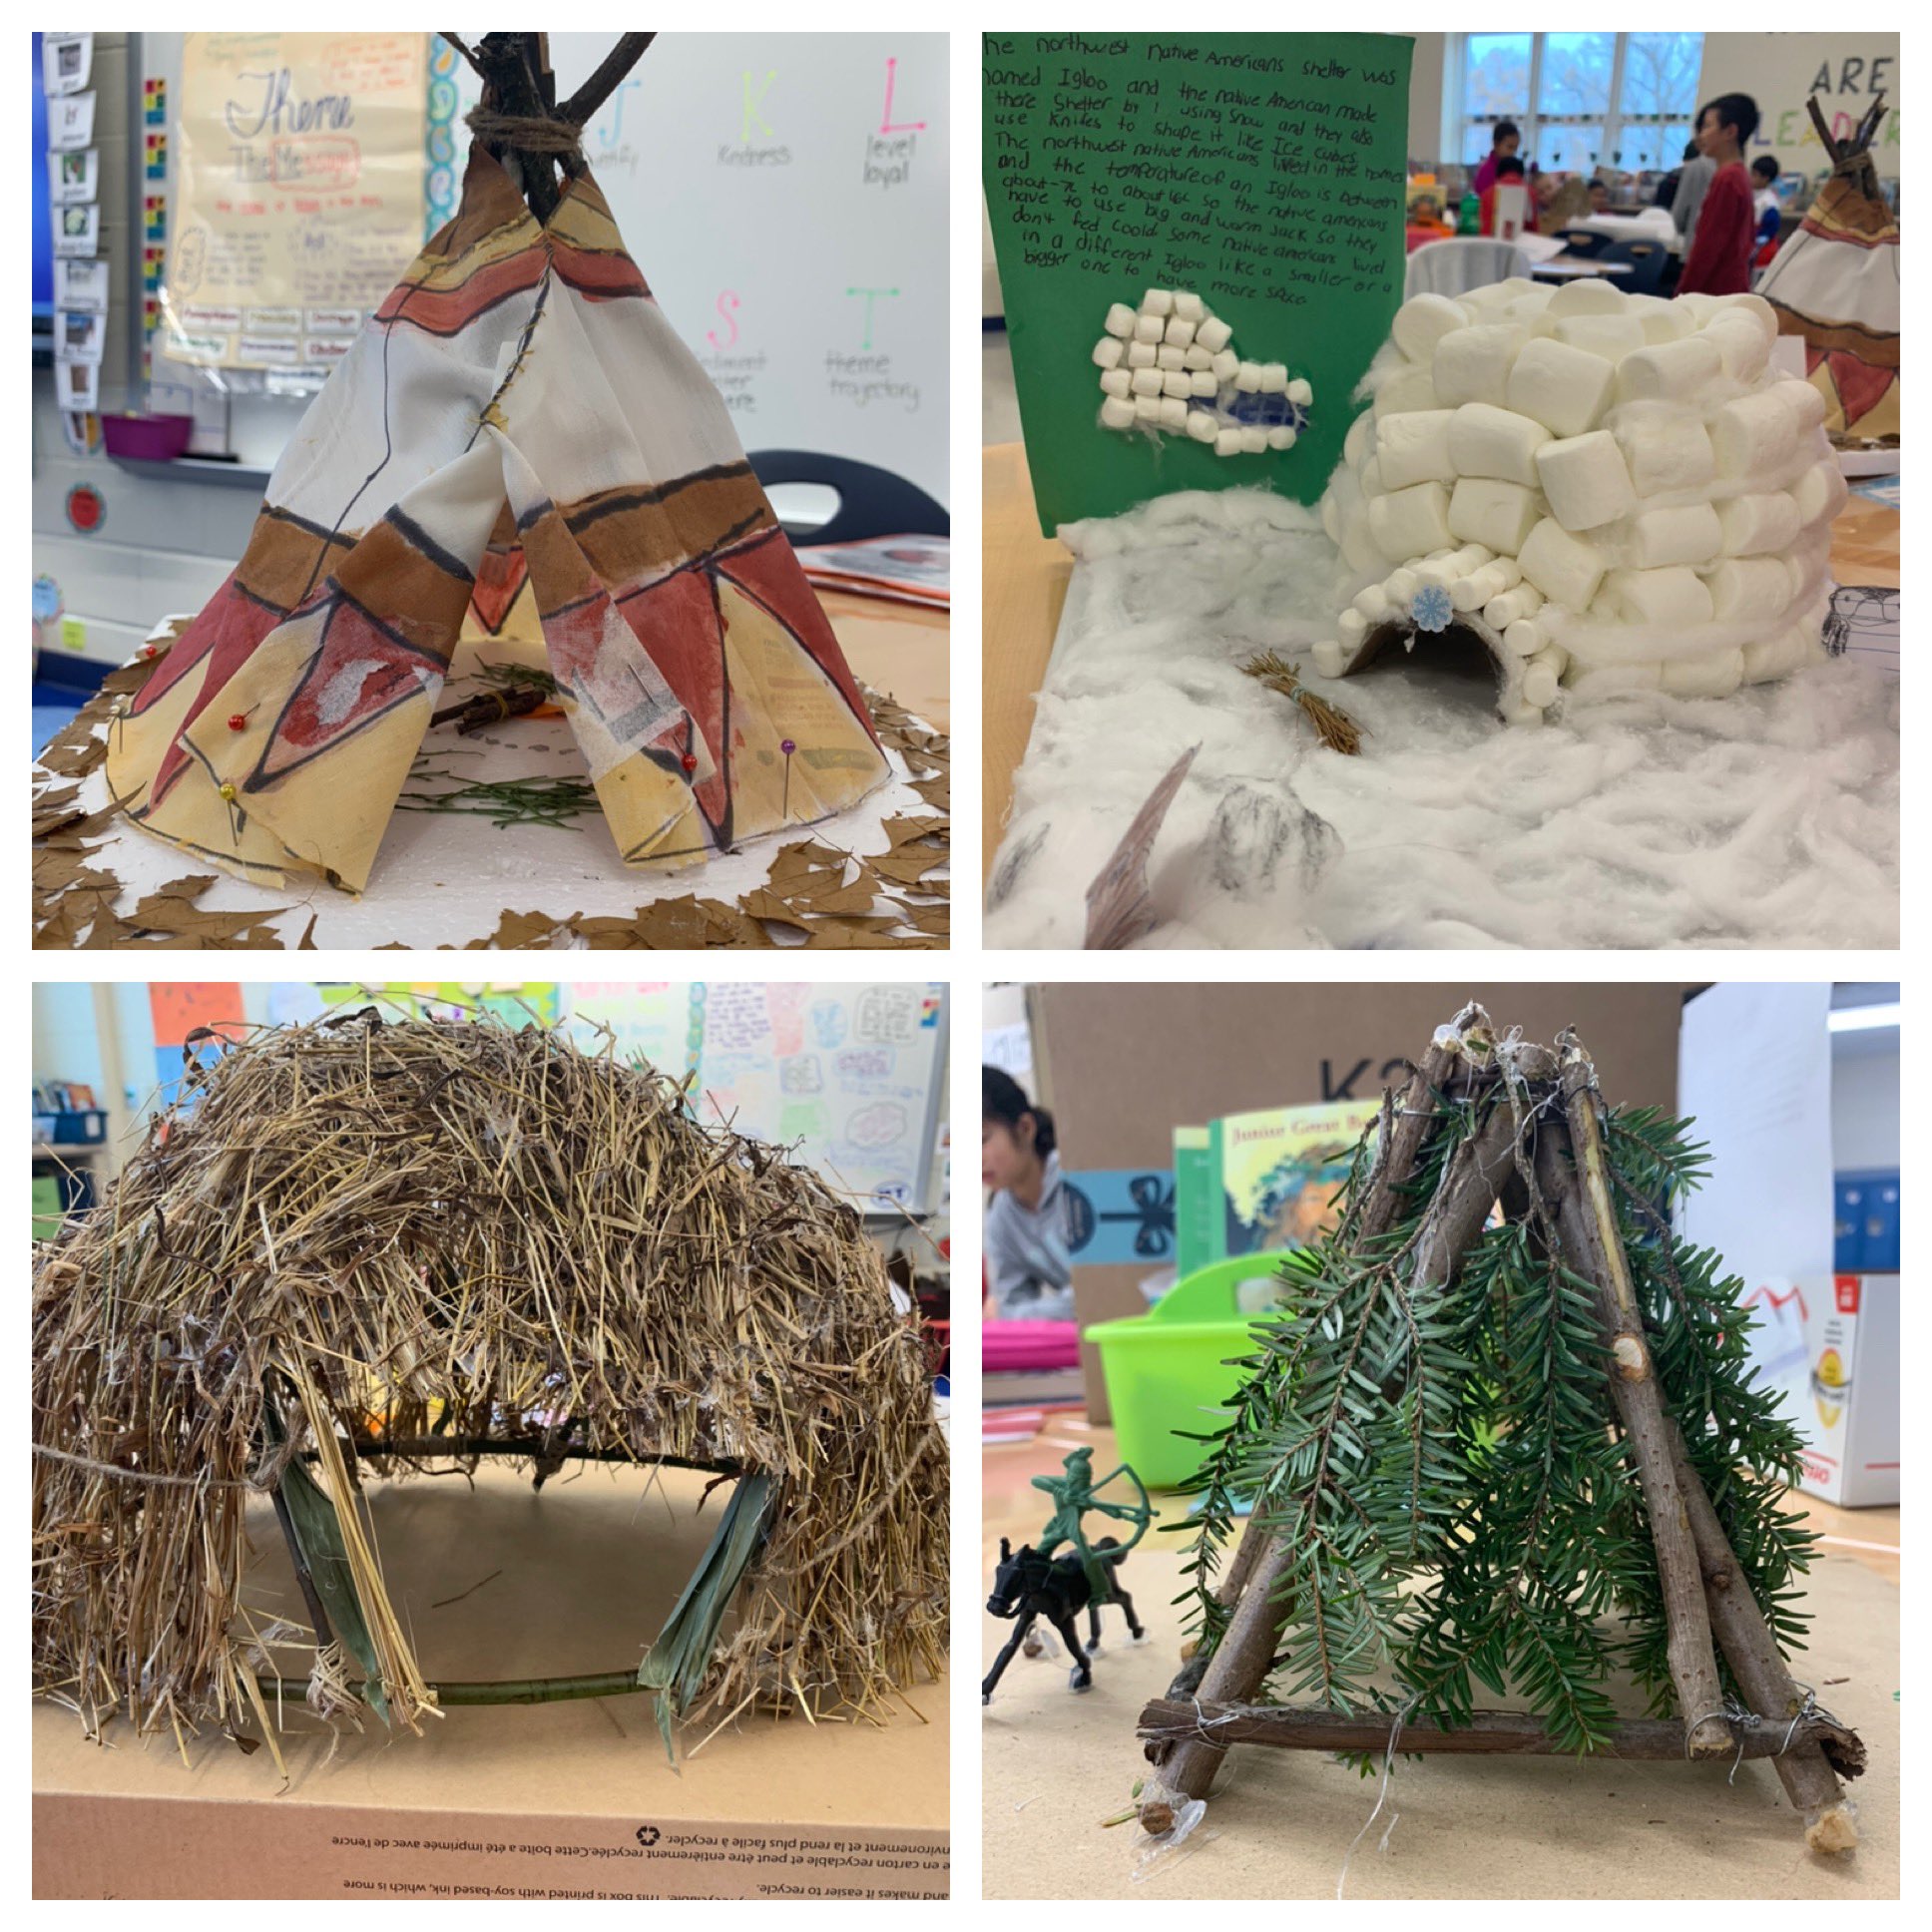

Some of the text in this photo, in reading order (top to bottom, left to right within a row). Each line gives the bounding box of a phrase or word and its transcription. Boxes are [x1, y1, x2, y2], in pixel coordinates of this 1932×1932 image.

[1809, 57, 1894, 94] ARE
[1058, 67, 1108, 91] Igloo
[1127, 80, 1160, 96] and
[373, 1838, 390, 1850] de
[392, 1839, 421, 1849] avec
[423, 1841, 483, 1853] imprimée
[731, 1838, 766, 1850] facile
[769, 1838, 796, 1851] plus
[799, 1840, 830, 1852] rend
[833, 1842, 845, 1853] la
[848, 1842, 862, 1852] et
[646, 1850, 725, 1863] entièrement
[727, 1853, 754, 1864] être
[756, 1853, 787, 1864] peut
[790, 1856, 804, 1866] et
[807, 1855, 873, 1869] recyclable
[876, 1859, 919, 1870] carton
[922, 1861, 940, 1870] en
[343, 1880, 374, 1890] more
[377, 1882, 387, 1892] is
[388, 1882, 426, 1894] which
[453, 1885, 515, 1897] soy-based
[807, 1886, 821, 1896] to
[824, 1887, 863, 1898] easier
